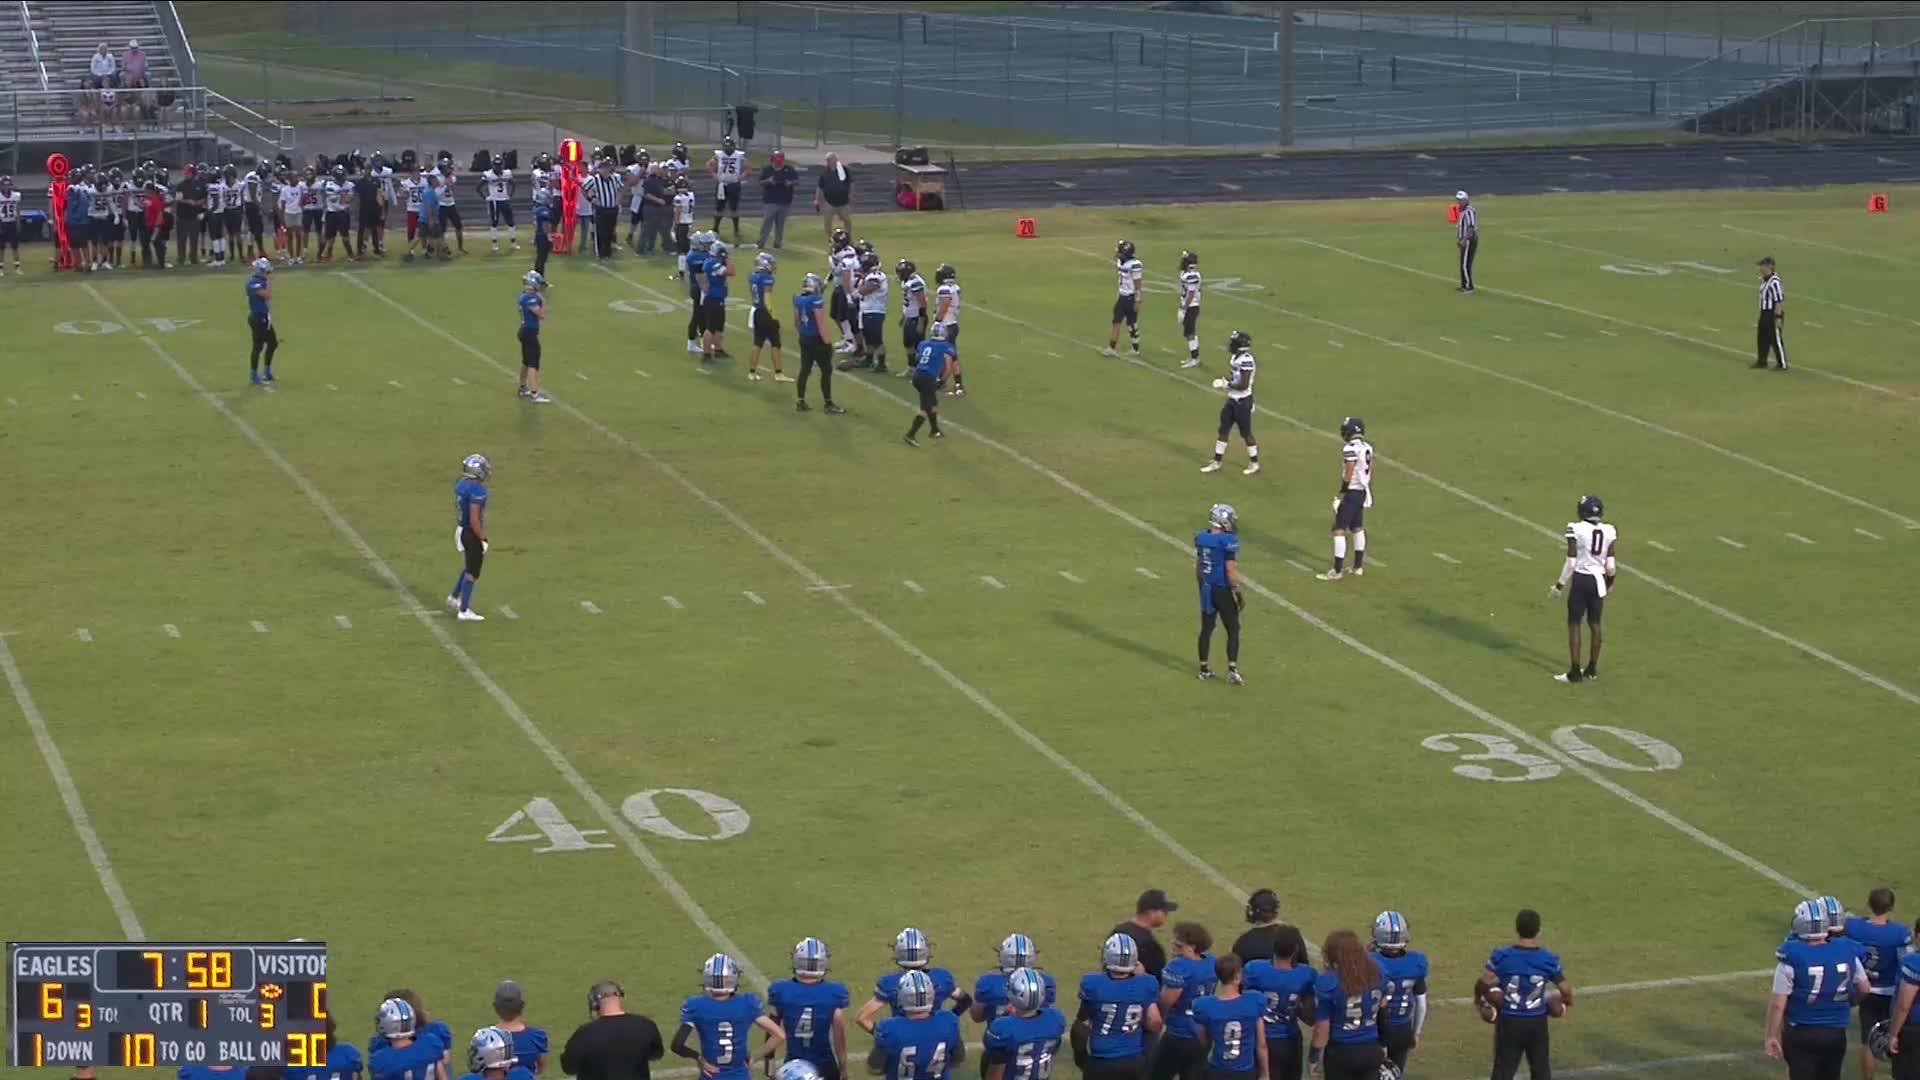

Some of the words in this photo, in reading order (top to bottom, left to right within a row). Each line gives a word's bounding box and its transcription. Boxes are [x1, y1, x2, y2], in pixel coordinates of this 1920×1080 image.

[722, 162, 736, 174] 75
[496, 181, 505, 193] 3
[1875, 196, 1885, 210] G
[1020, 220, 1035, 235] 20
[920, 345, 933, 365] 8
[1364, 448, 1372, 476] 9
[1590, 528, 1604, 556] 0
[1421, 723, 1683, 782] 30
[486, 787, 751, 853] 40
[1504, 974, 1544, 1010] 42
[1808, 963, 1851, 1004] 72
[717, 1021, 734, 1064] 3
[794, 1006, 815, 1049] 4
[1223, 1020, 1242, 1060] 9
[897, 1041, 947, 1080] 64
